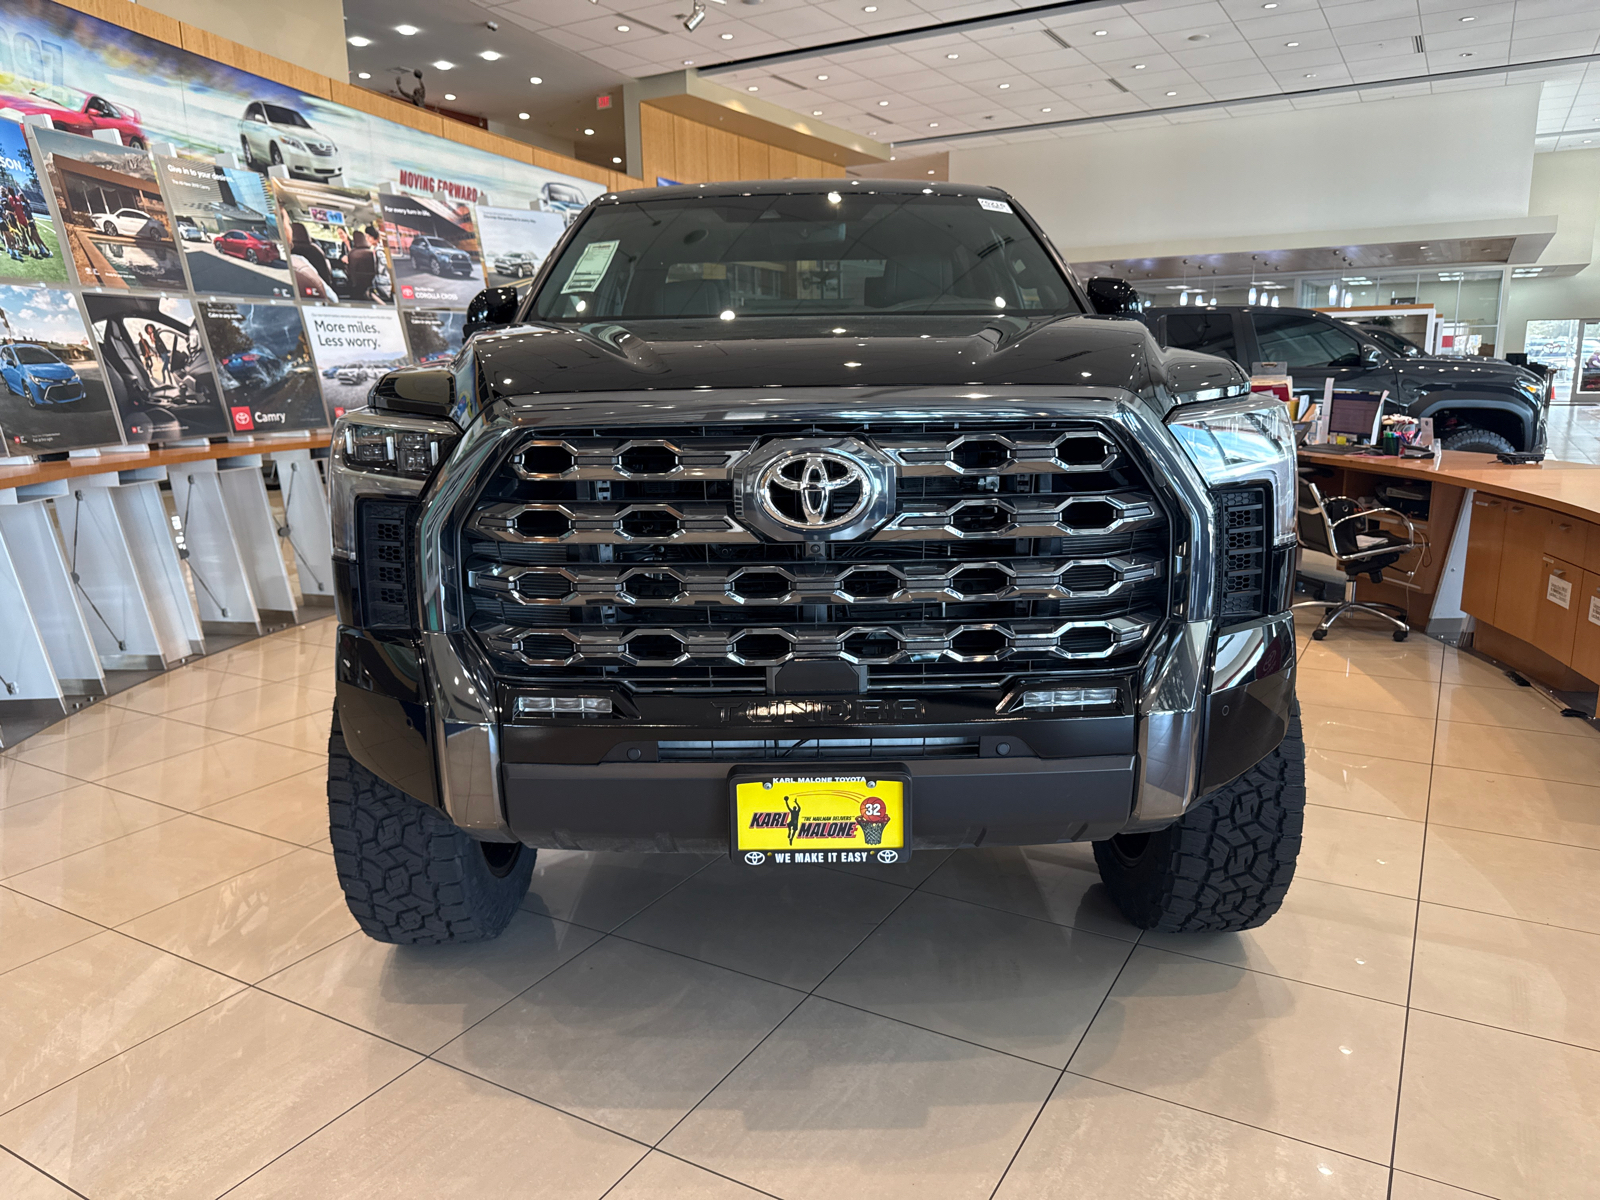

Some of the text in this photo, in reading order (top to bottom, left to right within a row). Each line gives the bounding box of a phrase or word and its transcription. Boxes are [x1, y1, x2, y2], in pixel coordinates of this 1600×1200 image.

[182, 167, 190, 175] in
[399, 169, 435, 193] MOVING
[314, 320, 380, 334] More miles.
[317, 334, 381, 350] Less worry.
[254, 411, 286, 424] Camry
[711, 699, 926, 722] TUNDRA
[865, 803, 881, 816] 32
[749, 811, 790, 829] KARL
[797, 821, 859, 839] MALONE
[774, 851, 868, 864] WE MAKE IT EASY
